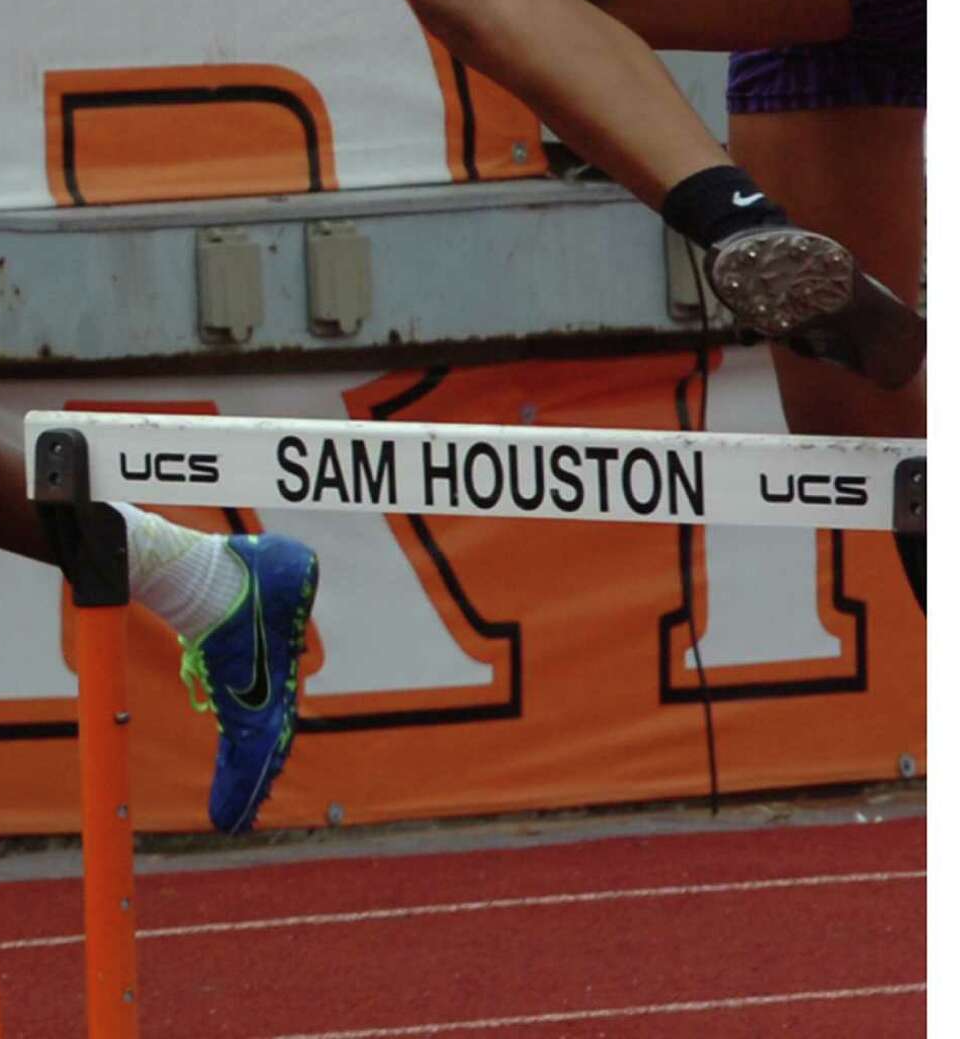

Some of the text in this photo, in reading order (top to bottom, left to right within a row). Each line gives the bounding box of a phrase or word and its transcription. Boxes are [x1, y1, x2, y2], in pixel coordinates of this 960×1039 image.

[119, 452, 221, 483] UCS
[276, 435, 705, 517] SAM HOUSTON
[759, 473, 869, 506] UCS
